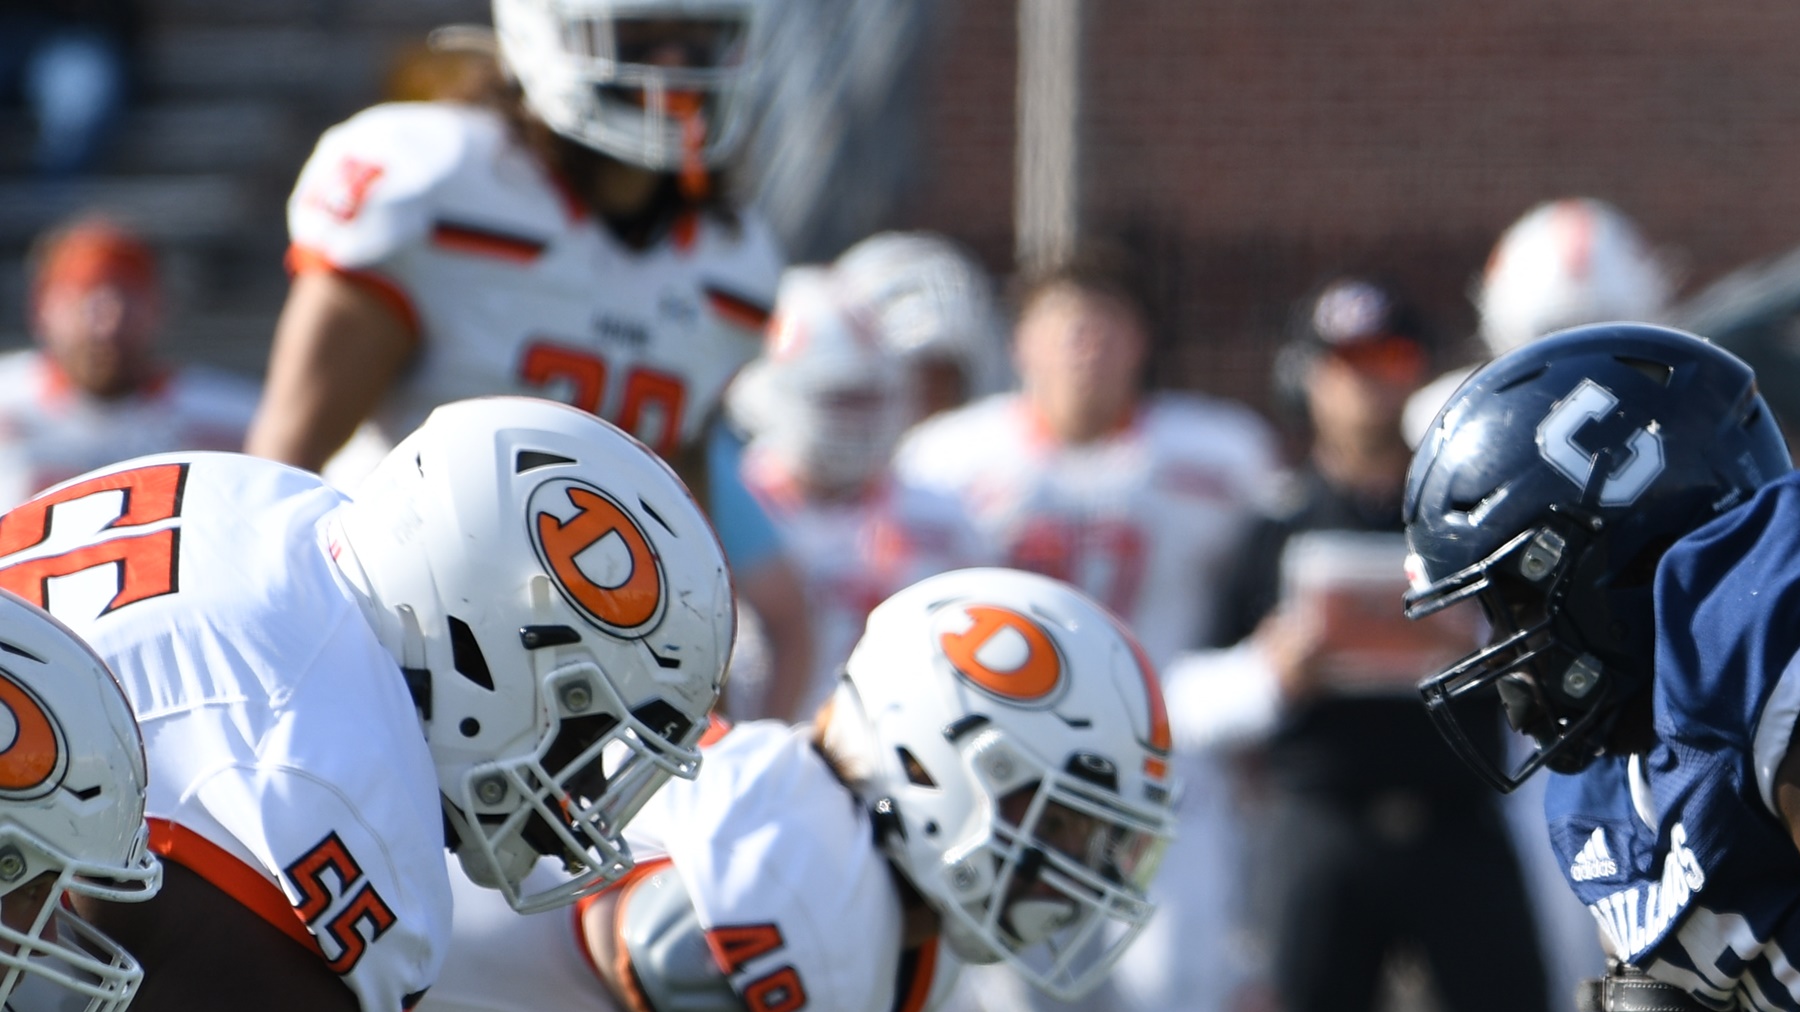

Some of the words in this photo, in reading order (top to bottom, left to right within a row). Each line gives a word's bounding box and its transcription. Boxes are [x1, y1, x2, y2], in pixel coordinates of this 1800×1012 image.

[1535, 377, 1666, 507] C
[537, 486, 661, 629] D
[940, 604, 1061, 700] D
[283, 829, 398, 976] 55
[1570, 856, 1617, 882] adidas
